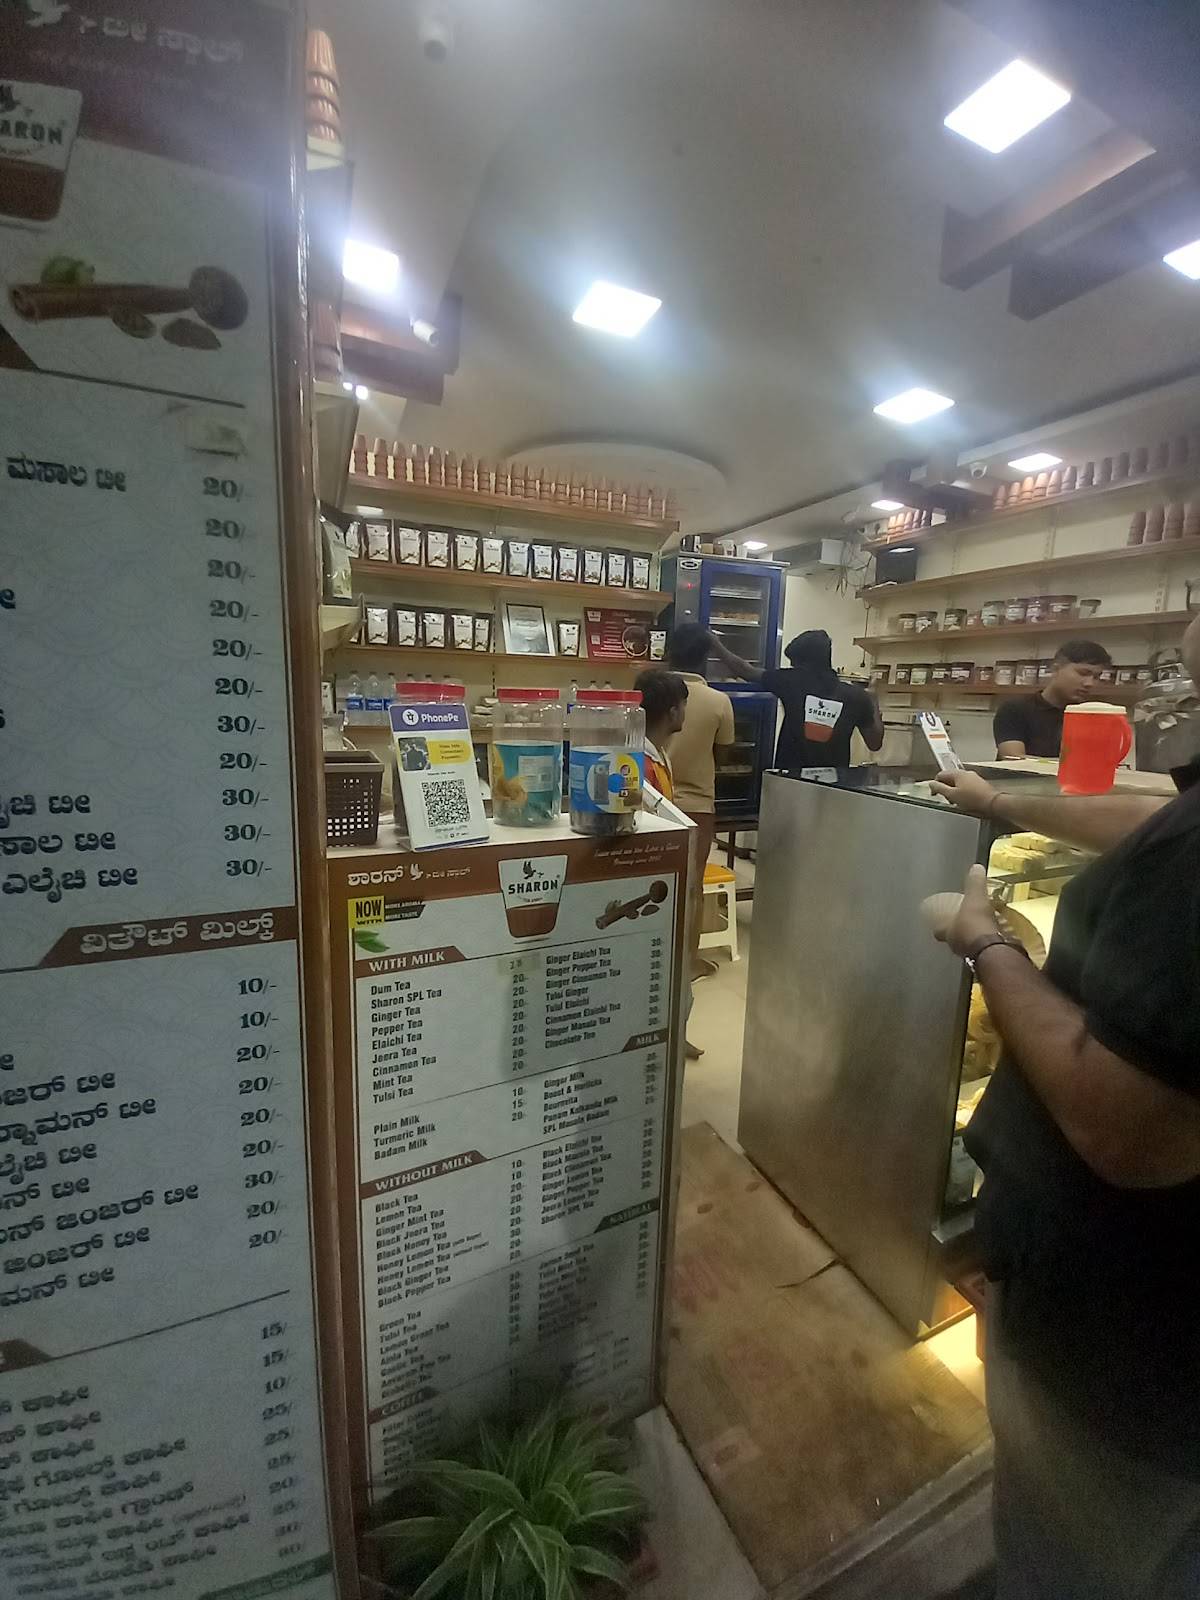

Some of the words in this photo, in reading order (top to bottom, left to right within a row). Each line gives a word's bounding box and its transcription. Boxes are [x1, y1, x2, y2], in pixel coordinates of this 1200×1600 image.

[209, 600, 259, 622] 20/-
[212, 639, 262, 661] 20/-
[215, 678, 263, 699] 20/-
[217, 715, 266, 736] 30/-
[421, 713, 460, 724] PhonePe
[219, 752, 268, 773] 20/-
[222, 788, 269, 808] 30/-
[224, 824, 271, 842] 30/-
[226, 859, 273, 877] 30/-
[508, 879, 559, 895] SHARON
[355, 900, 383, 918] NOW
[369, 956, 407, 973] WITH
[411, 951, 446, 967] MILK
[238, 978, 277, 995] 10/-
[371, 984, 392, 996] Dum
[395, 980, 411, 992] Tea
[371, 995, 404, 1010] Sharon
[407, 991, 423, 1003] SPL
[426, 988, 442, 1000] Tea
[240, 1011, 280, 1029] 10/-
[371, 1009, 402, 1023] Ginger
[405, 1005, 421, 1017] Tea
[372, 1022, 404, 1037] Pepper
[407, 1018, 423, 1030] Tea
[372, 1036, 404, 1050] Elaichi
[407, 1032, 423, 1043] Tea
[236, 1044, 280, 1063] 20/-
[402, 1047, 417, 1058] Tea
[372, 1058, 419, 1077] Cinnamon
[421, 1055, 437, 1067] Tea
[239, 1076, 281, 1095] 20/-
[373, 1078, 395, 1091] Mint
[398, 1074, 413, 1086] Tea
[373, 1092, 396, 1104] Tulsi
[398, 1086, 414, 1098] Tea
[374, 1122, 398, 1136] Plain
[400, 1114, 420, 1128] Milk
[374, 1129, 414, 1148] Turmeric
[417, 1122, 436, 1136] Milk
[374, 1145, 406, 1161] Badam
[409, 1137, 428, 1152] Milk
[375, 1166, 438, 1192] WITHOUT
[441, 1154, 474, 1172] MILK
[403, 1193, 419, 1205] Tea
